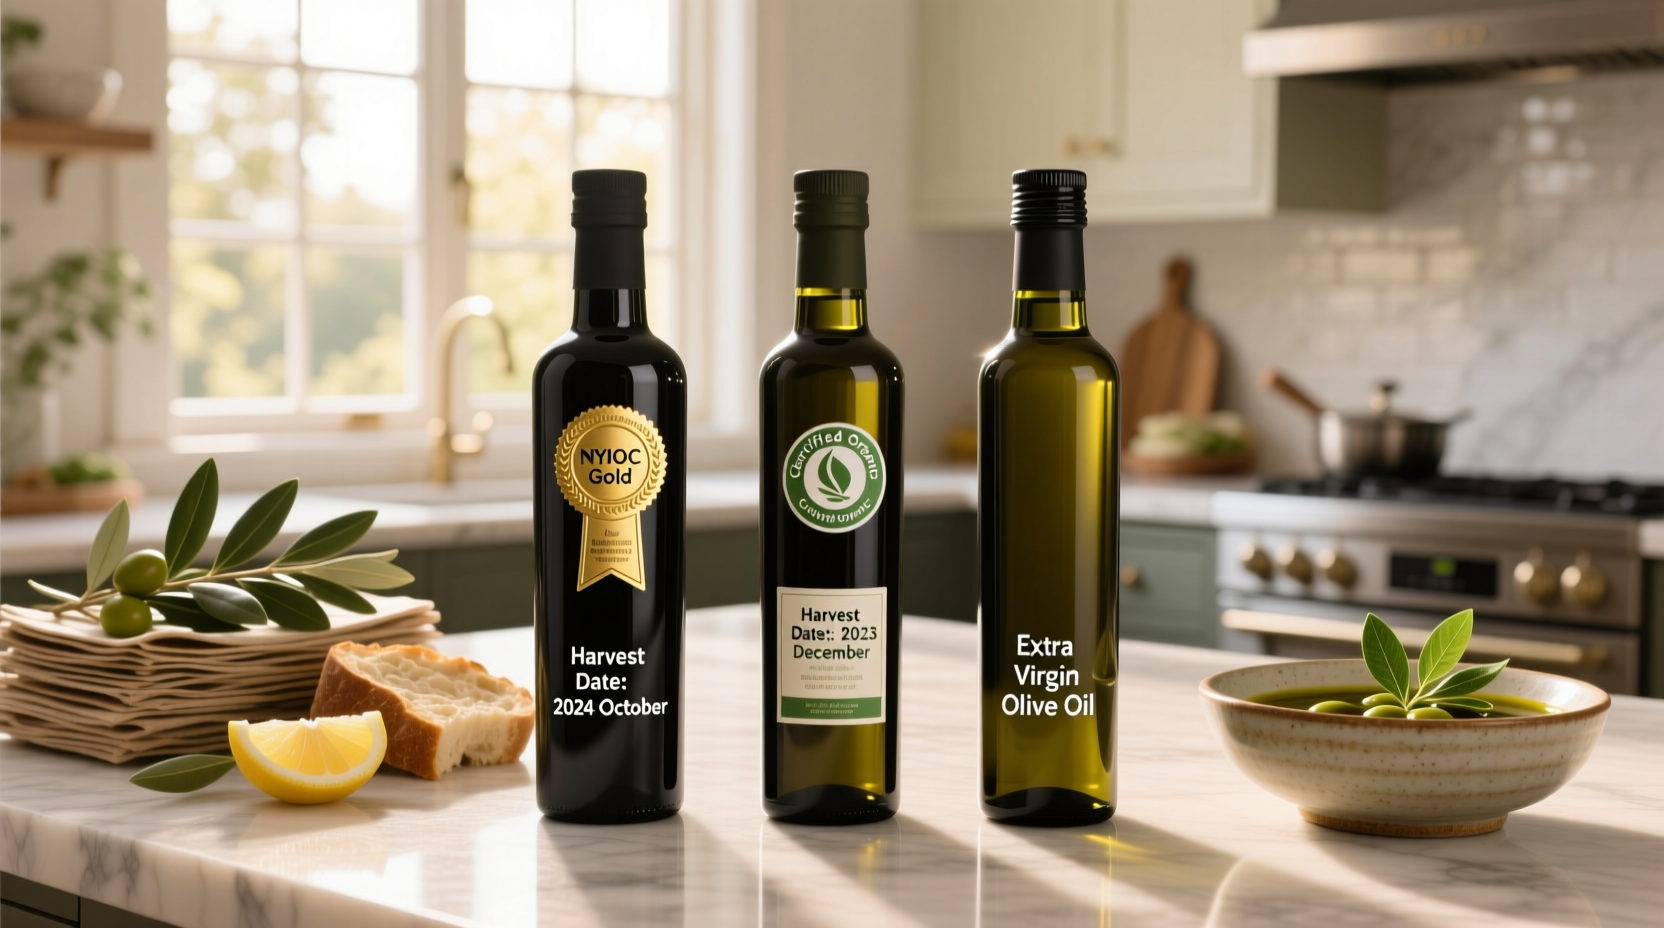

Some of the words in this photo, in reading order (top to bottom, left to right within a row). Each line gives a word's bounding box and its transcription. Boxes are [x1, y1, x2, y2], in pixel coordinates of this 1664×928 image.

[580, 448, 641, 465] NYIOC
[588, 467, 632, 485] Gold
[801, 607, 861, 622] Harvest
[793, 644, 871, 660] December
[1017, 633, 1074, 657] Extra
[571, 645, 646, 666] Harvest
[576, 672, 627, 691] Date:
[1013, 664, 1079, 693] Virgin
[553, 697, 595, 716] 2024
[598, 696, 668, 716] October
[1001, 693, 1059, 717] Olive
[1064, 692, 1094, 717] Oil
